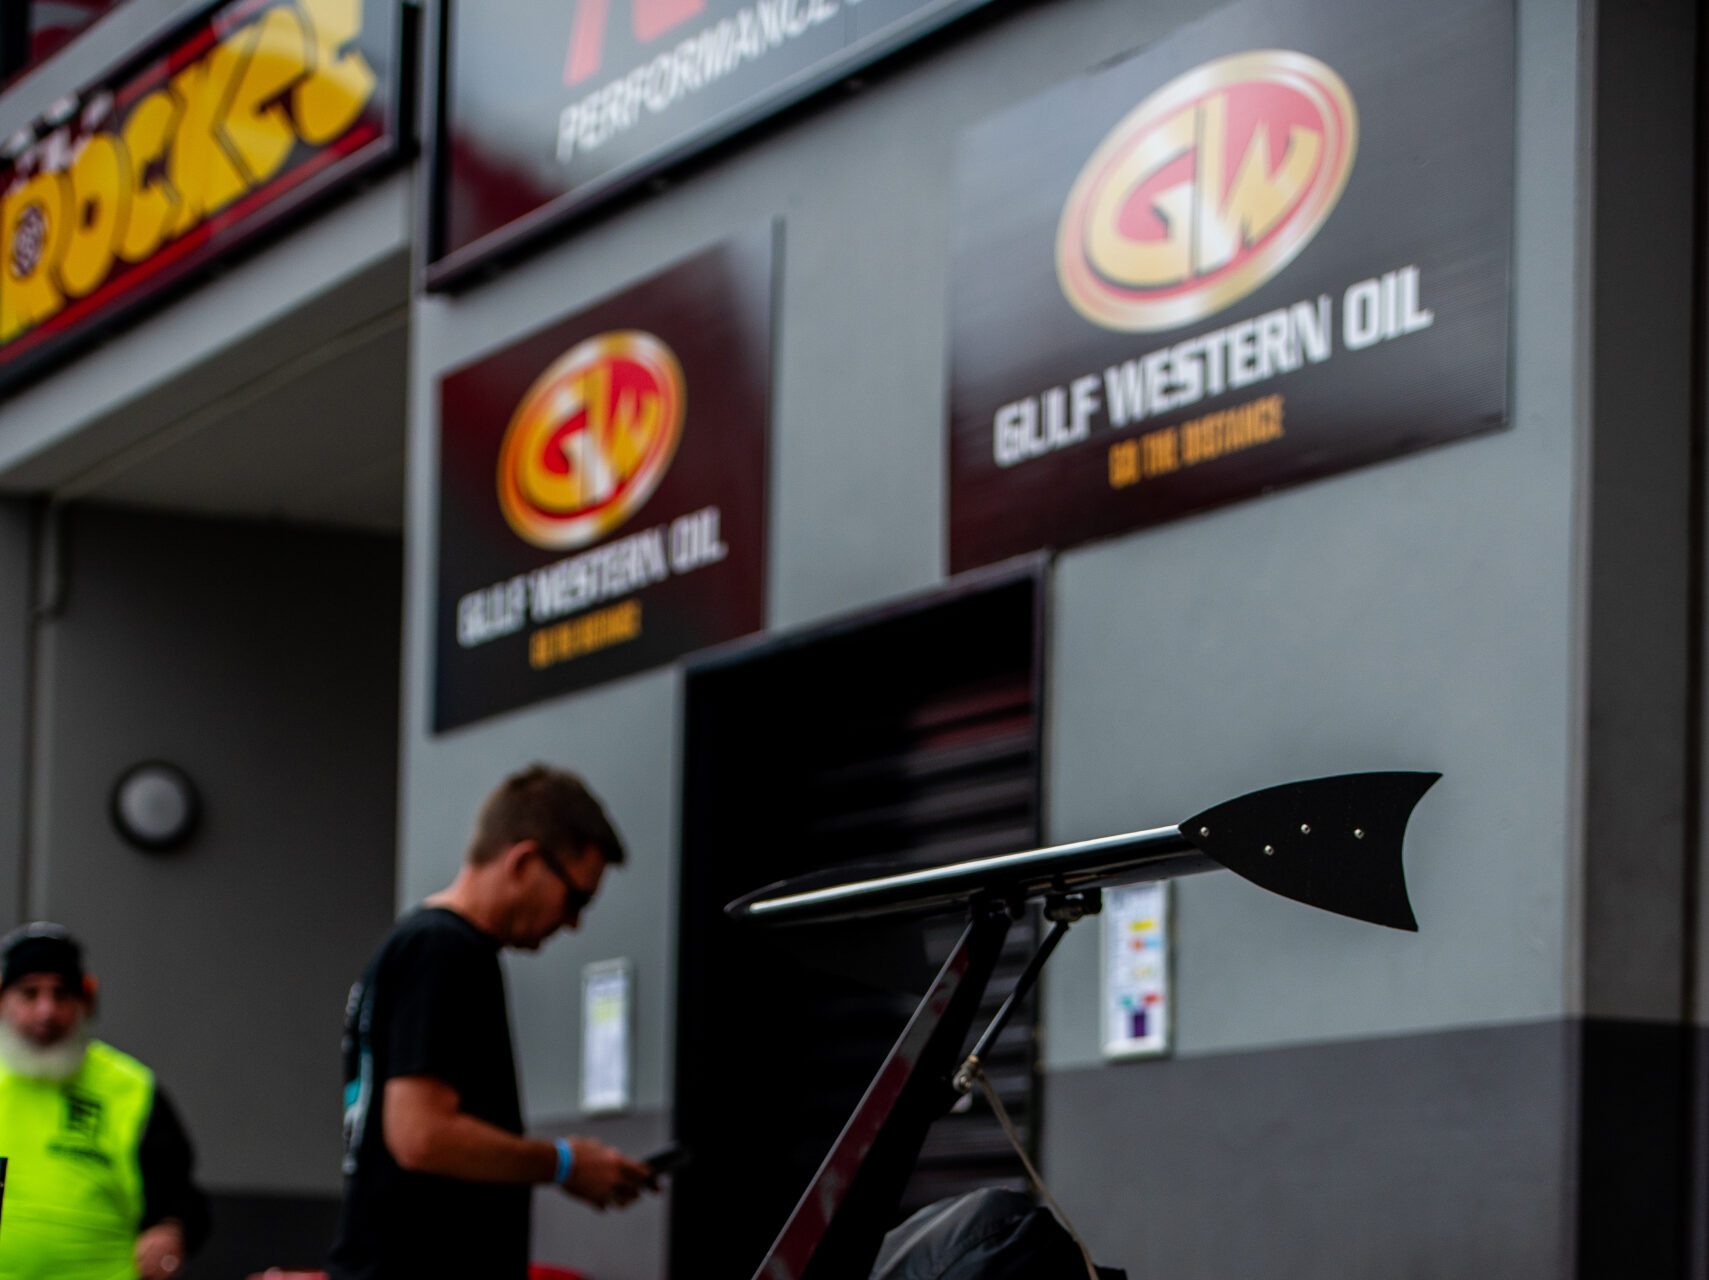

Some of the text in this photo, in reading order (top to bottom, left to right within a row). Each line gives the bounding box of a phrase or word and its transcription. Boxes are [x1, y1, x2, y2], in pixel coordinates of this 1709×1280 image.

[1088, 92, 1321, 287] GW
[993, 264, 1436, 468] GULF WESTERN OIL
